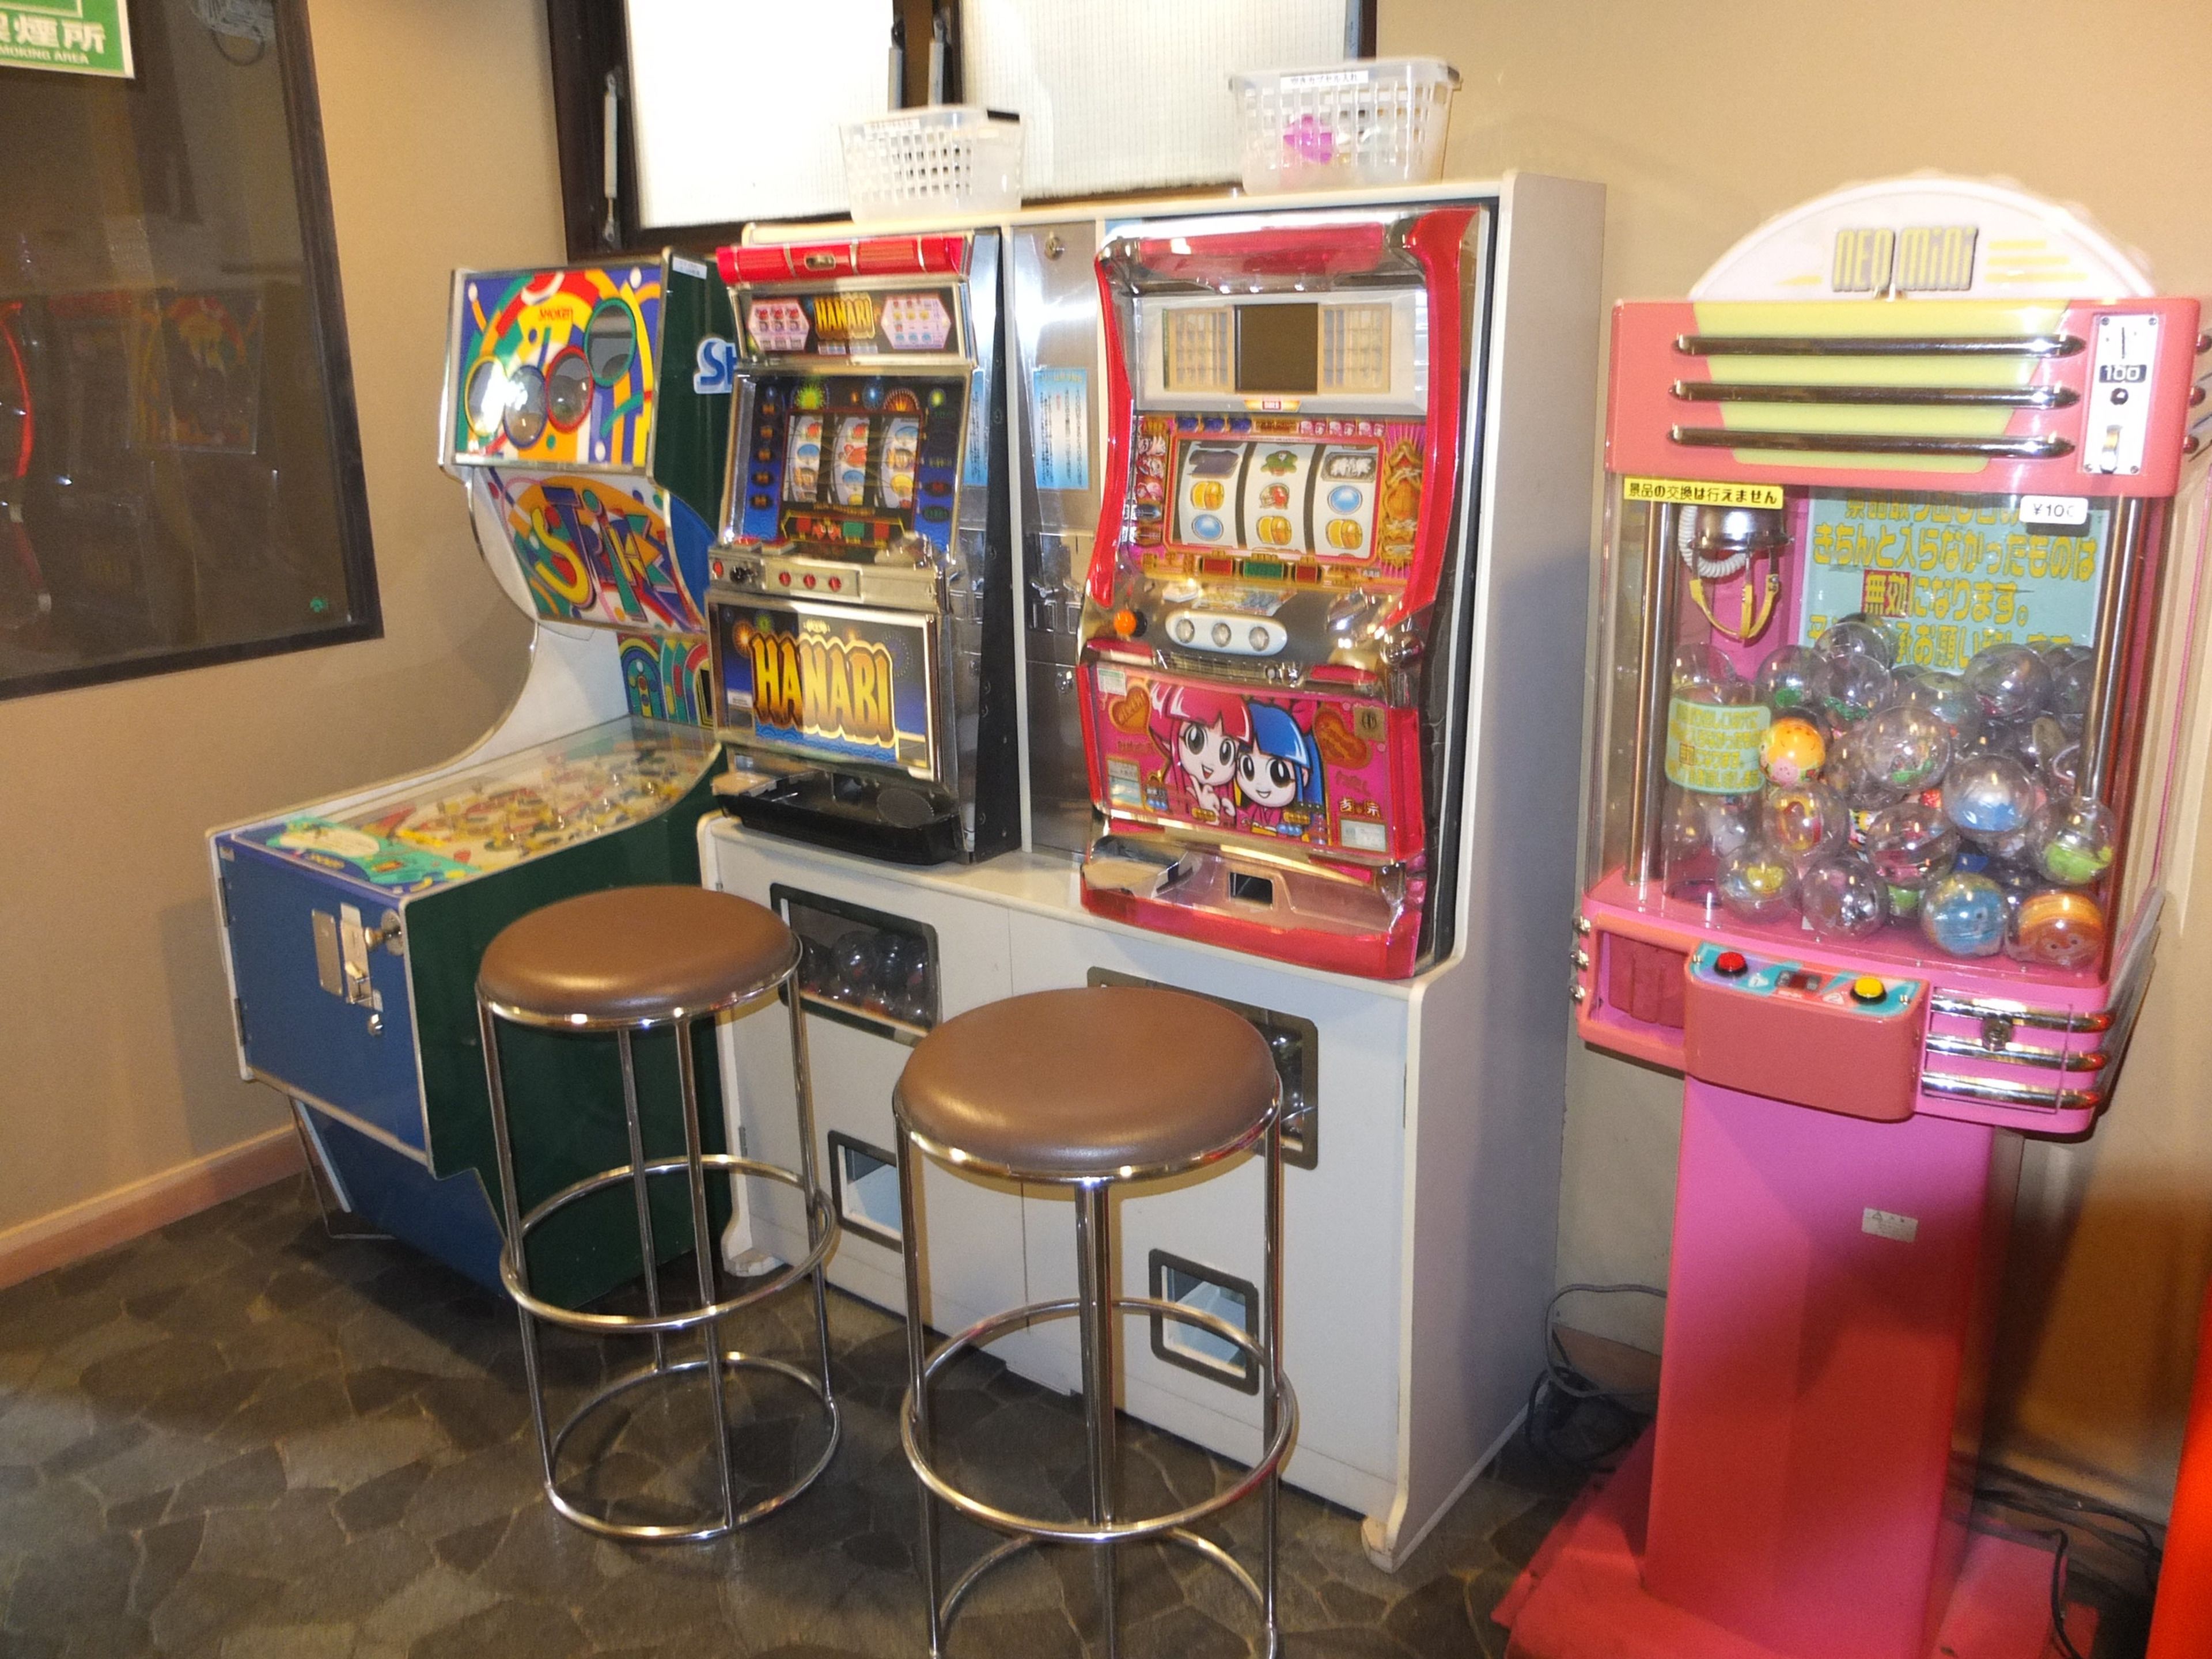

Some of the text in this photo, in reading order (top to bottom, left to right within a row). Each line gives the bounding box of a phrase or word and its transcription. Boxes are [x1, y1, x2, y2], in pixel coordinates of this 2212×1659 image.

[0, 12, 106, 54] 煙所
[813, 293, 876, 340] HANABI
[2103, 364, 2142, 382] 100
[1629, 482, 1778, 505] 景品の交換は行えません
[1813, 522, 2097, 582] きちんと入らなかったものは
[1864, 571, 2029, 627] 無効になります。
[749, 633, 896, 748] HANABI
